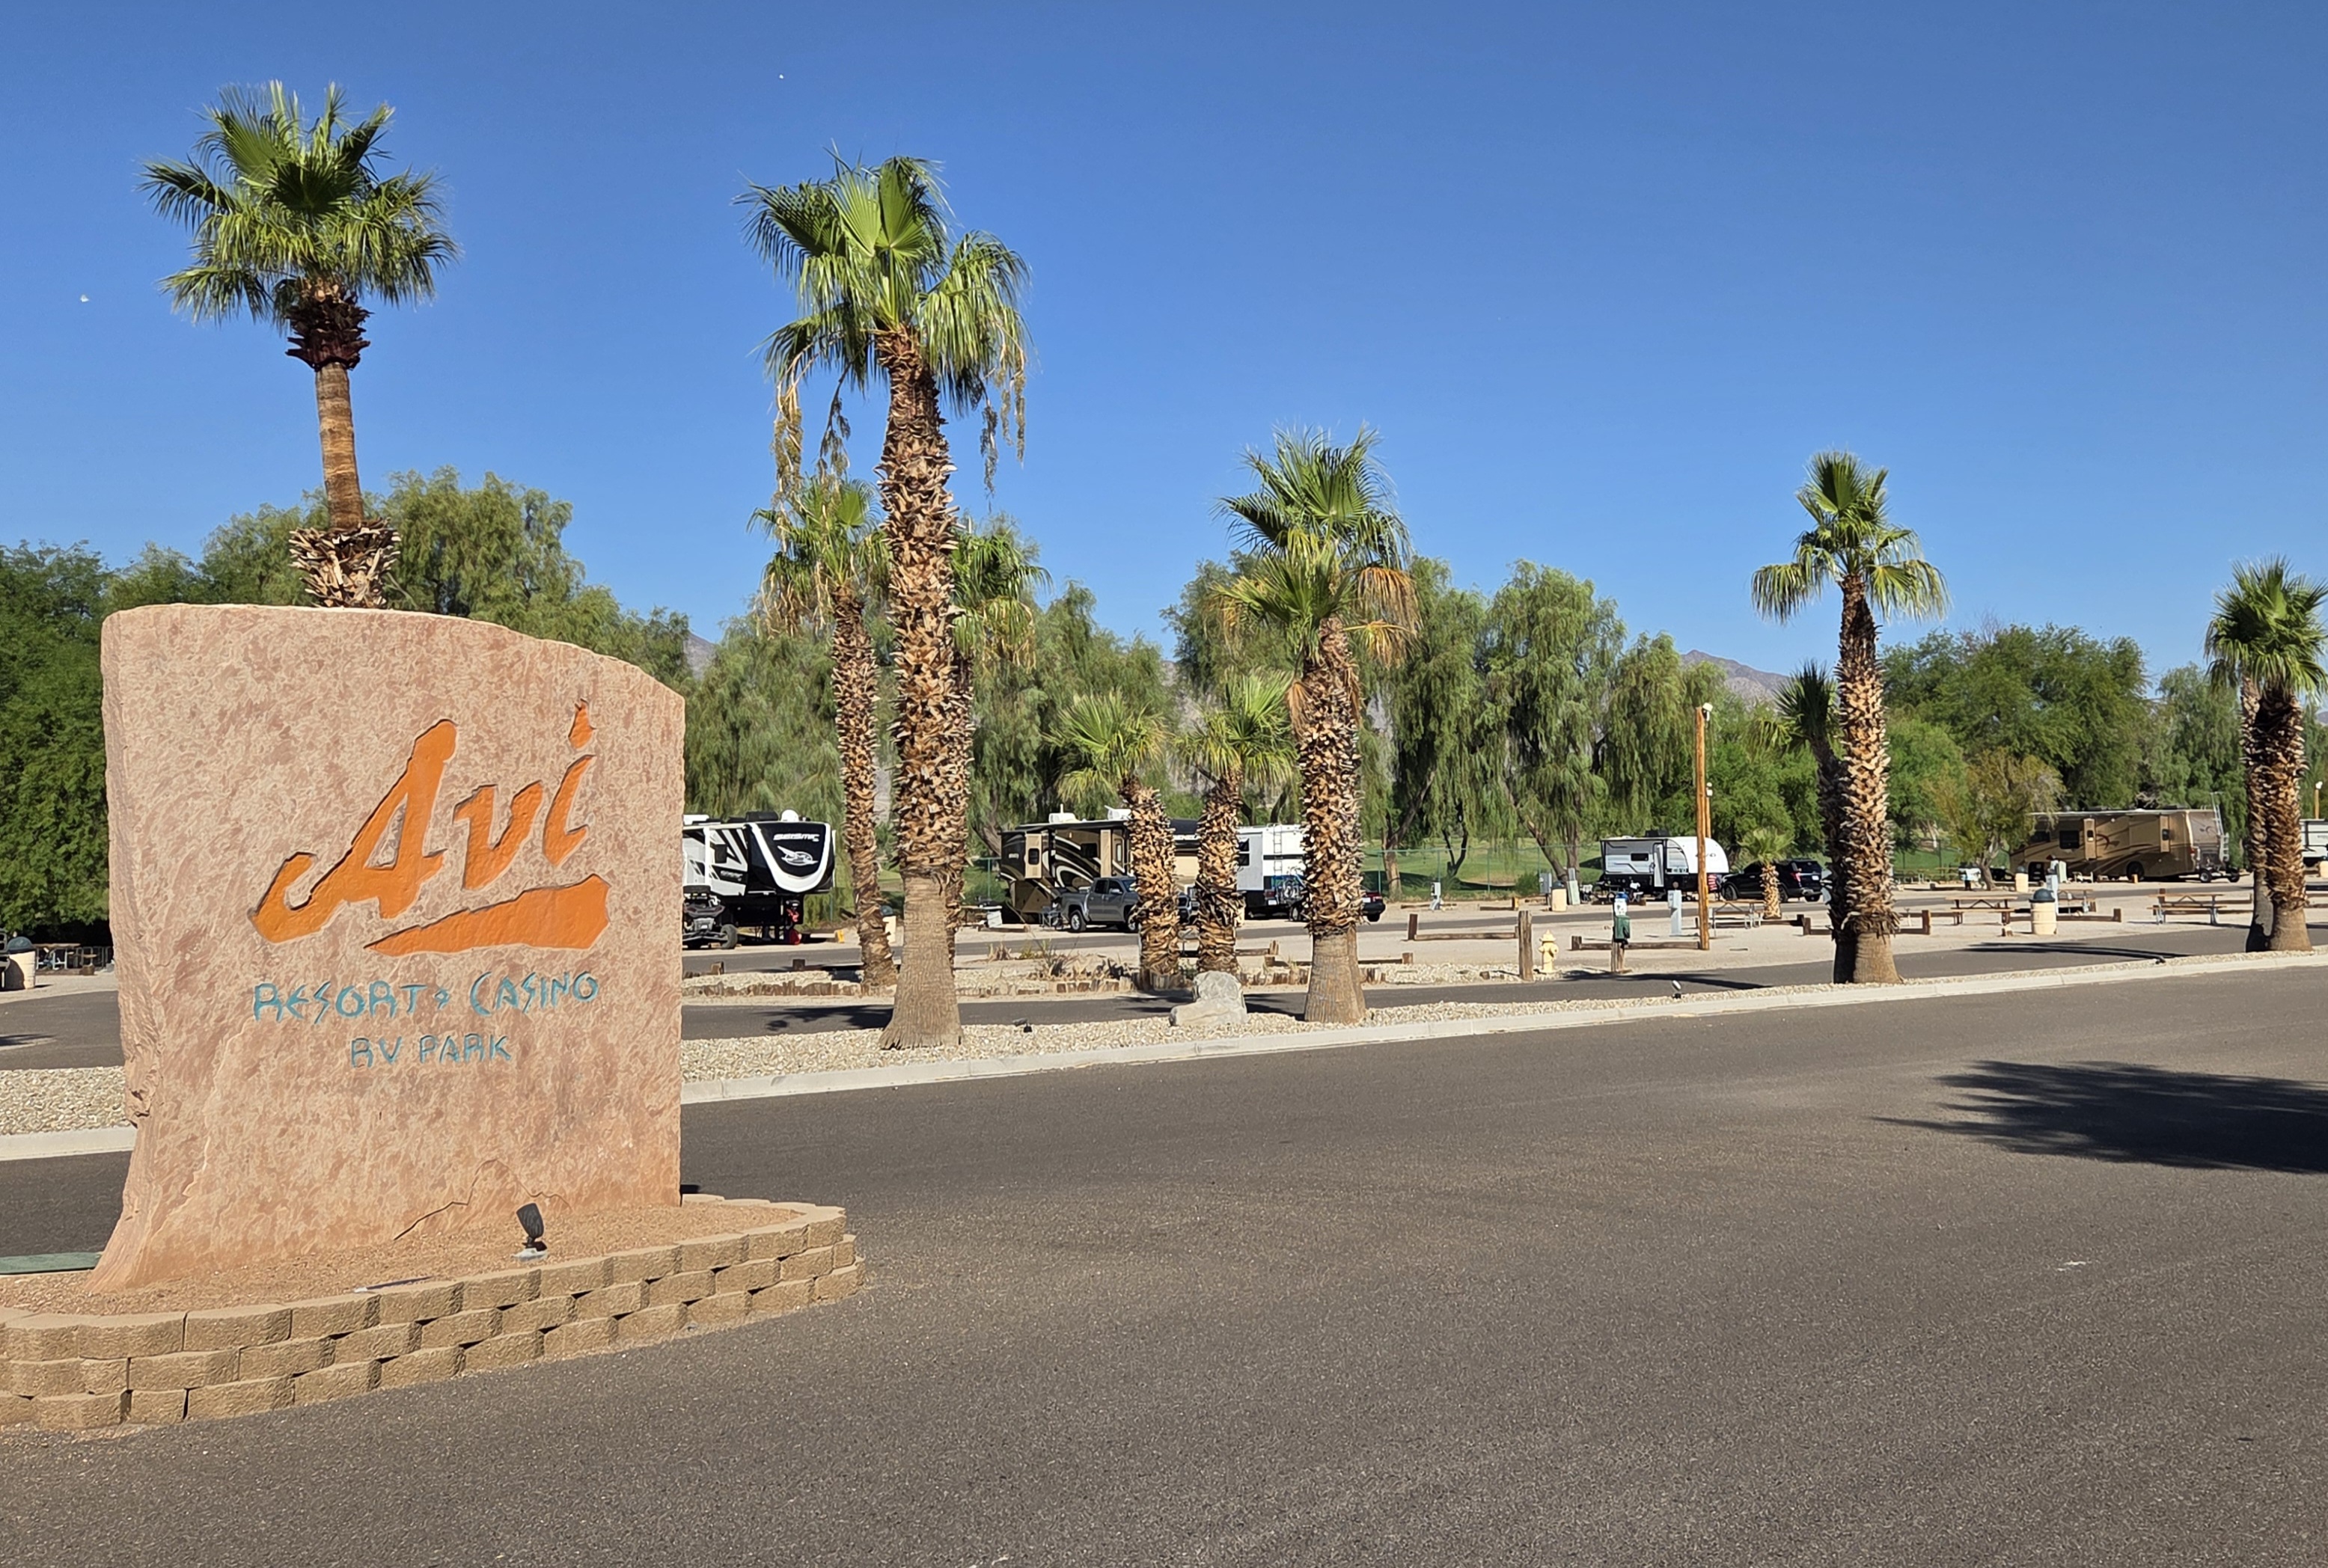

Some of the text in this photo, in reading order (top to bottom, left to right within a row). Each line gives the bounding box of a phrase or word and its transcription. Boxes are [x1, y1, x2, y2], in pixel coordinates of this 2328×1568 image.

[248, 699, 596, 944] Avi
[253, 980, 427, 1025] RESORT
[469, 970, 599, 1017] CASINO
[351, 1032, 513, 1068] RV PARK
